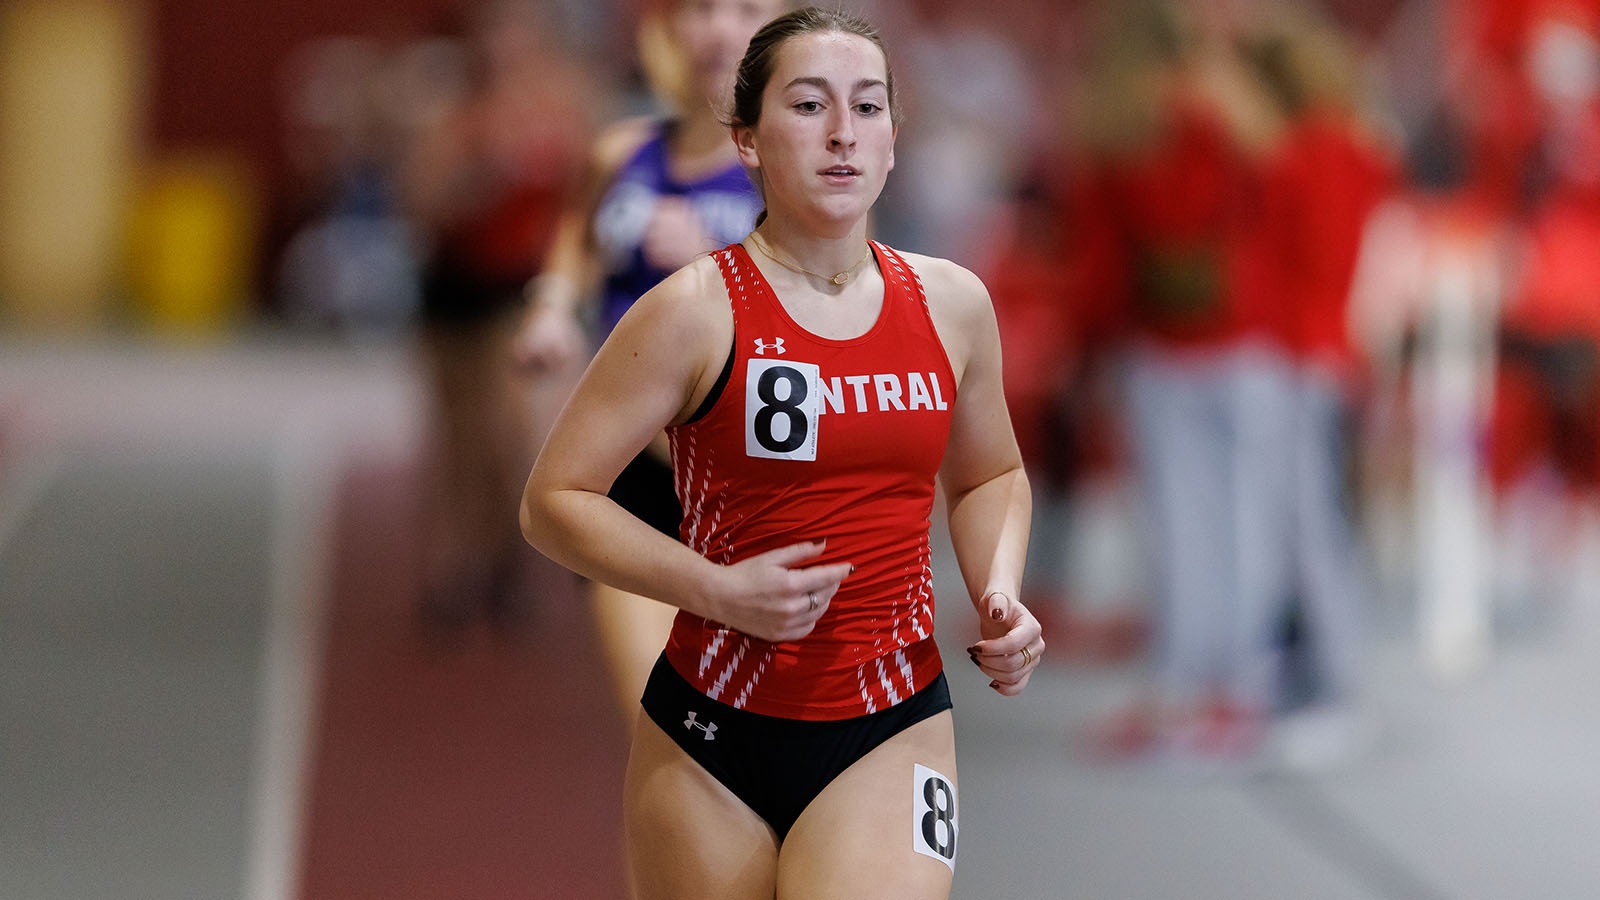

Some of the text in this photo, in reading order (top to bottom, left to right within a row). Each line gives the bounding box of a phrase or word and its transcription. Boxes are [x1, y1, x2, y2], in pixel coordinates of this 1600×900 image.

[754, 366, 808, 453] 8
[819, 372, 948, 414] NTRAL
[922, 777, 955, 859] 8
